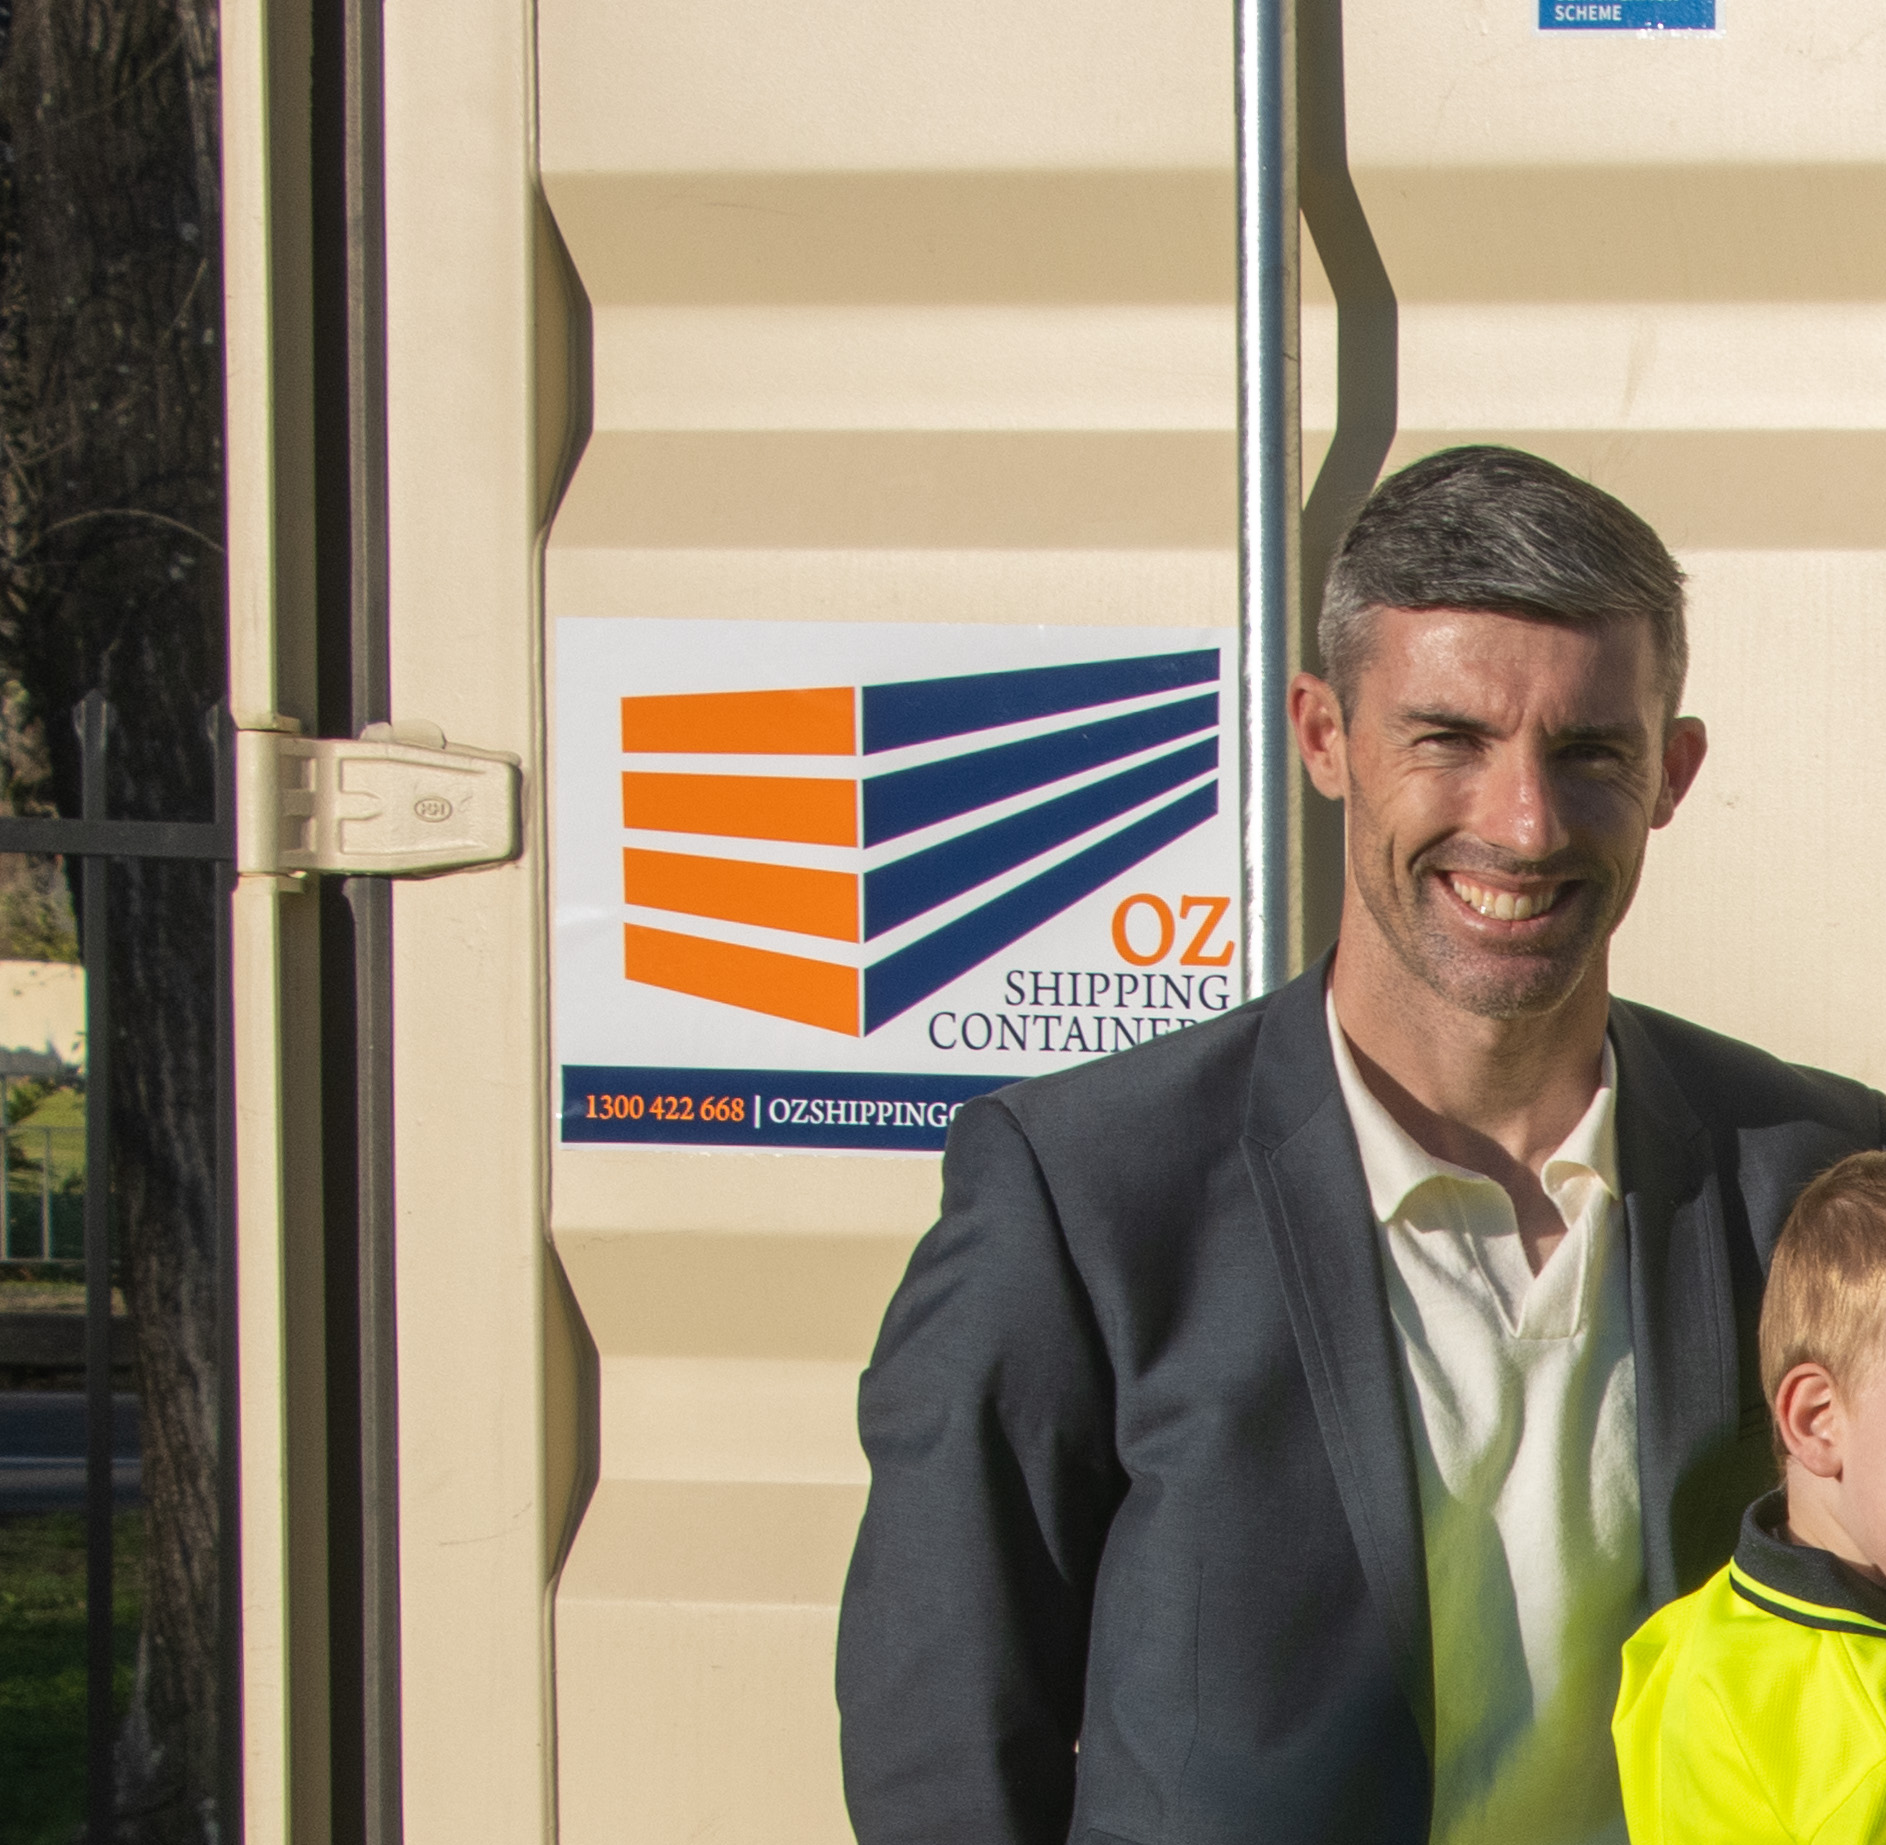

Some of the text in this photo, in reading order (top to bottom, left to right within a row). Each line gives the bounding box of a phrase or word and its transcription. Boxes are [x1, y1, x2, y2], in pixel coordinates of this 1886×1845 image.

[1554, 4, 1622, 21] SCHEME
[1111, 892, 1236, 967] OZ
[1005, 970, 1231, 1012] SHIPPING
[928, 1011, 1201, 1054] CONTAINE
[586, 1094, 644, 1119] 1300
[649, 1096, 694, 1121] 422
[700, 1097, 745, 1122] 668
